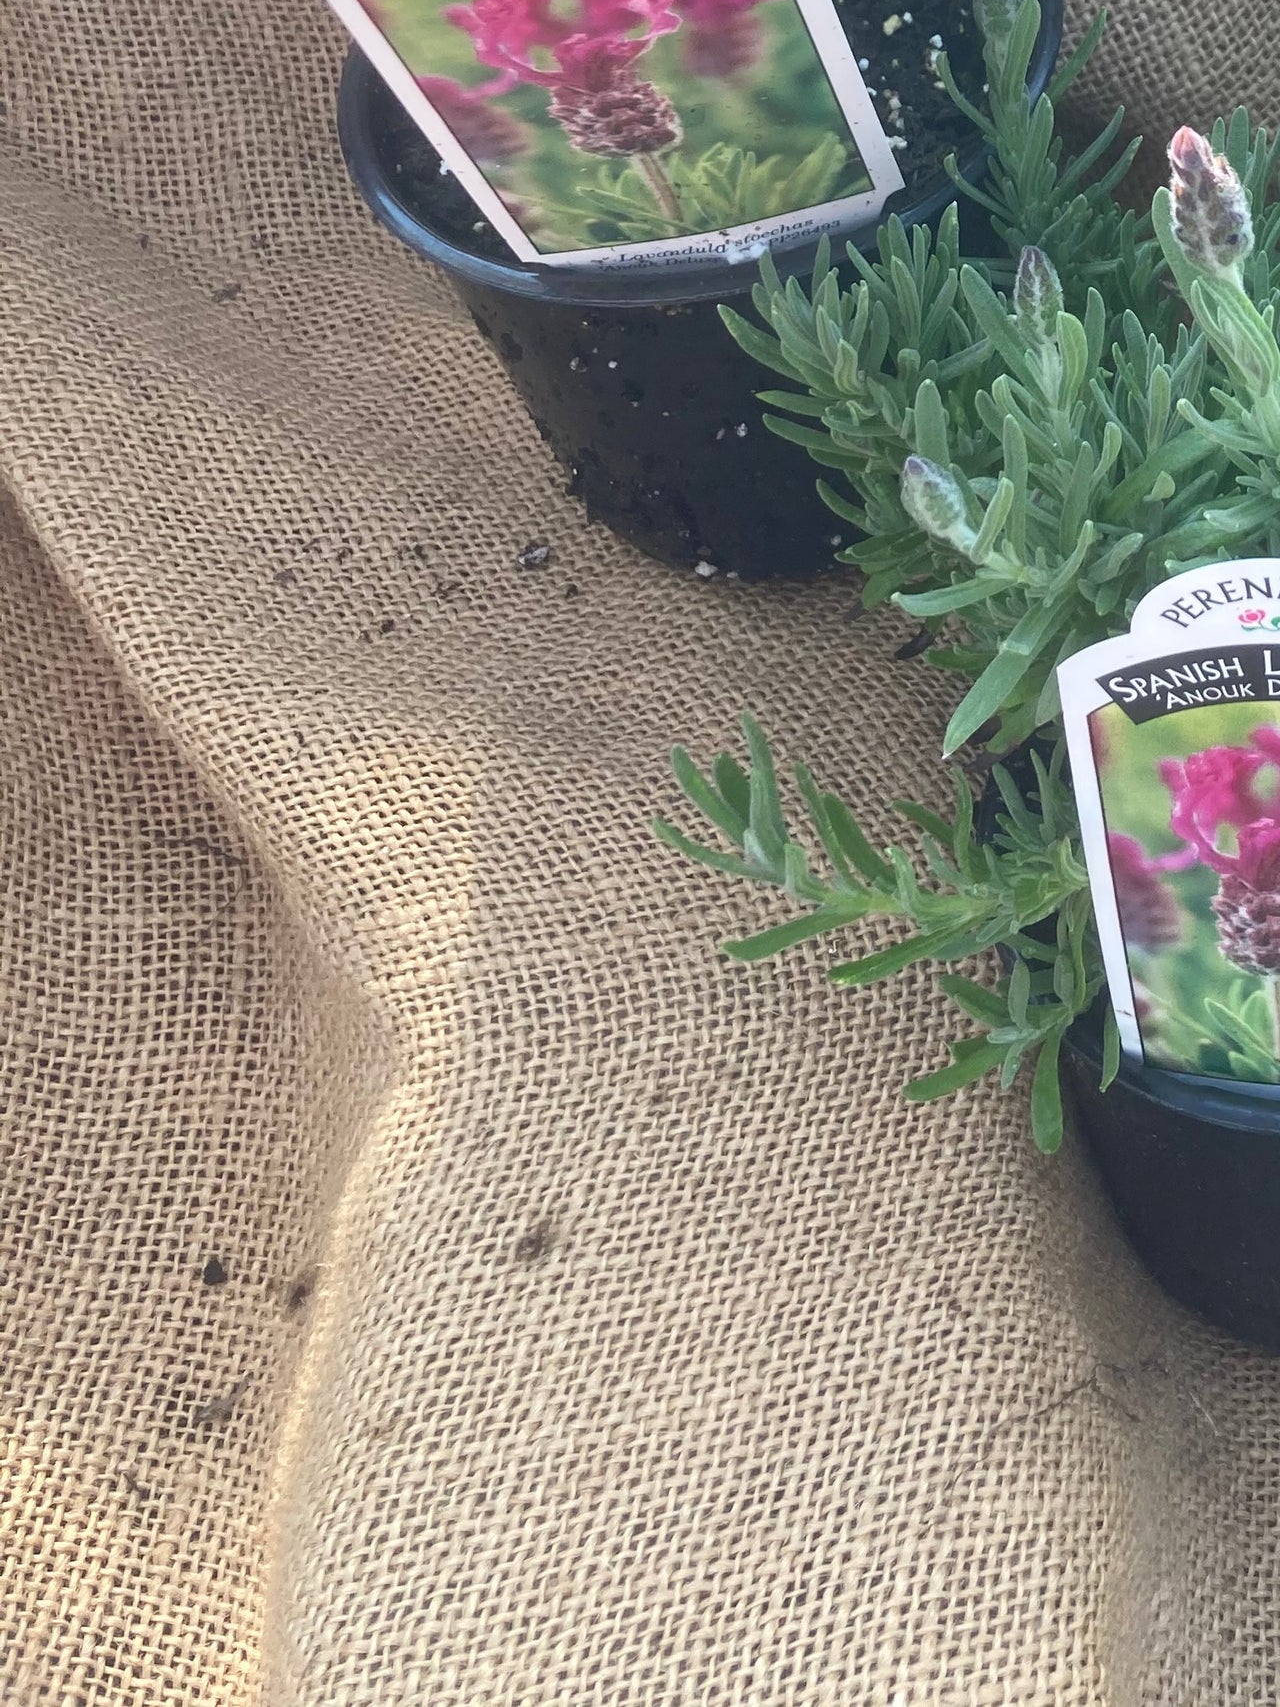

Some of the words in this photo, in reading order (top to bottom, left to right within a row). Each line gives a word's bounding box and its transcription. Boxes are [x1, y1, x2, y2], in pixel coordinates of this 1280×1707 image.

[619, 242, 727, 262] Lavandula
[734, 218, 814, 247] stoechas
[1109, 657, 1245, 703] SPANISH
